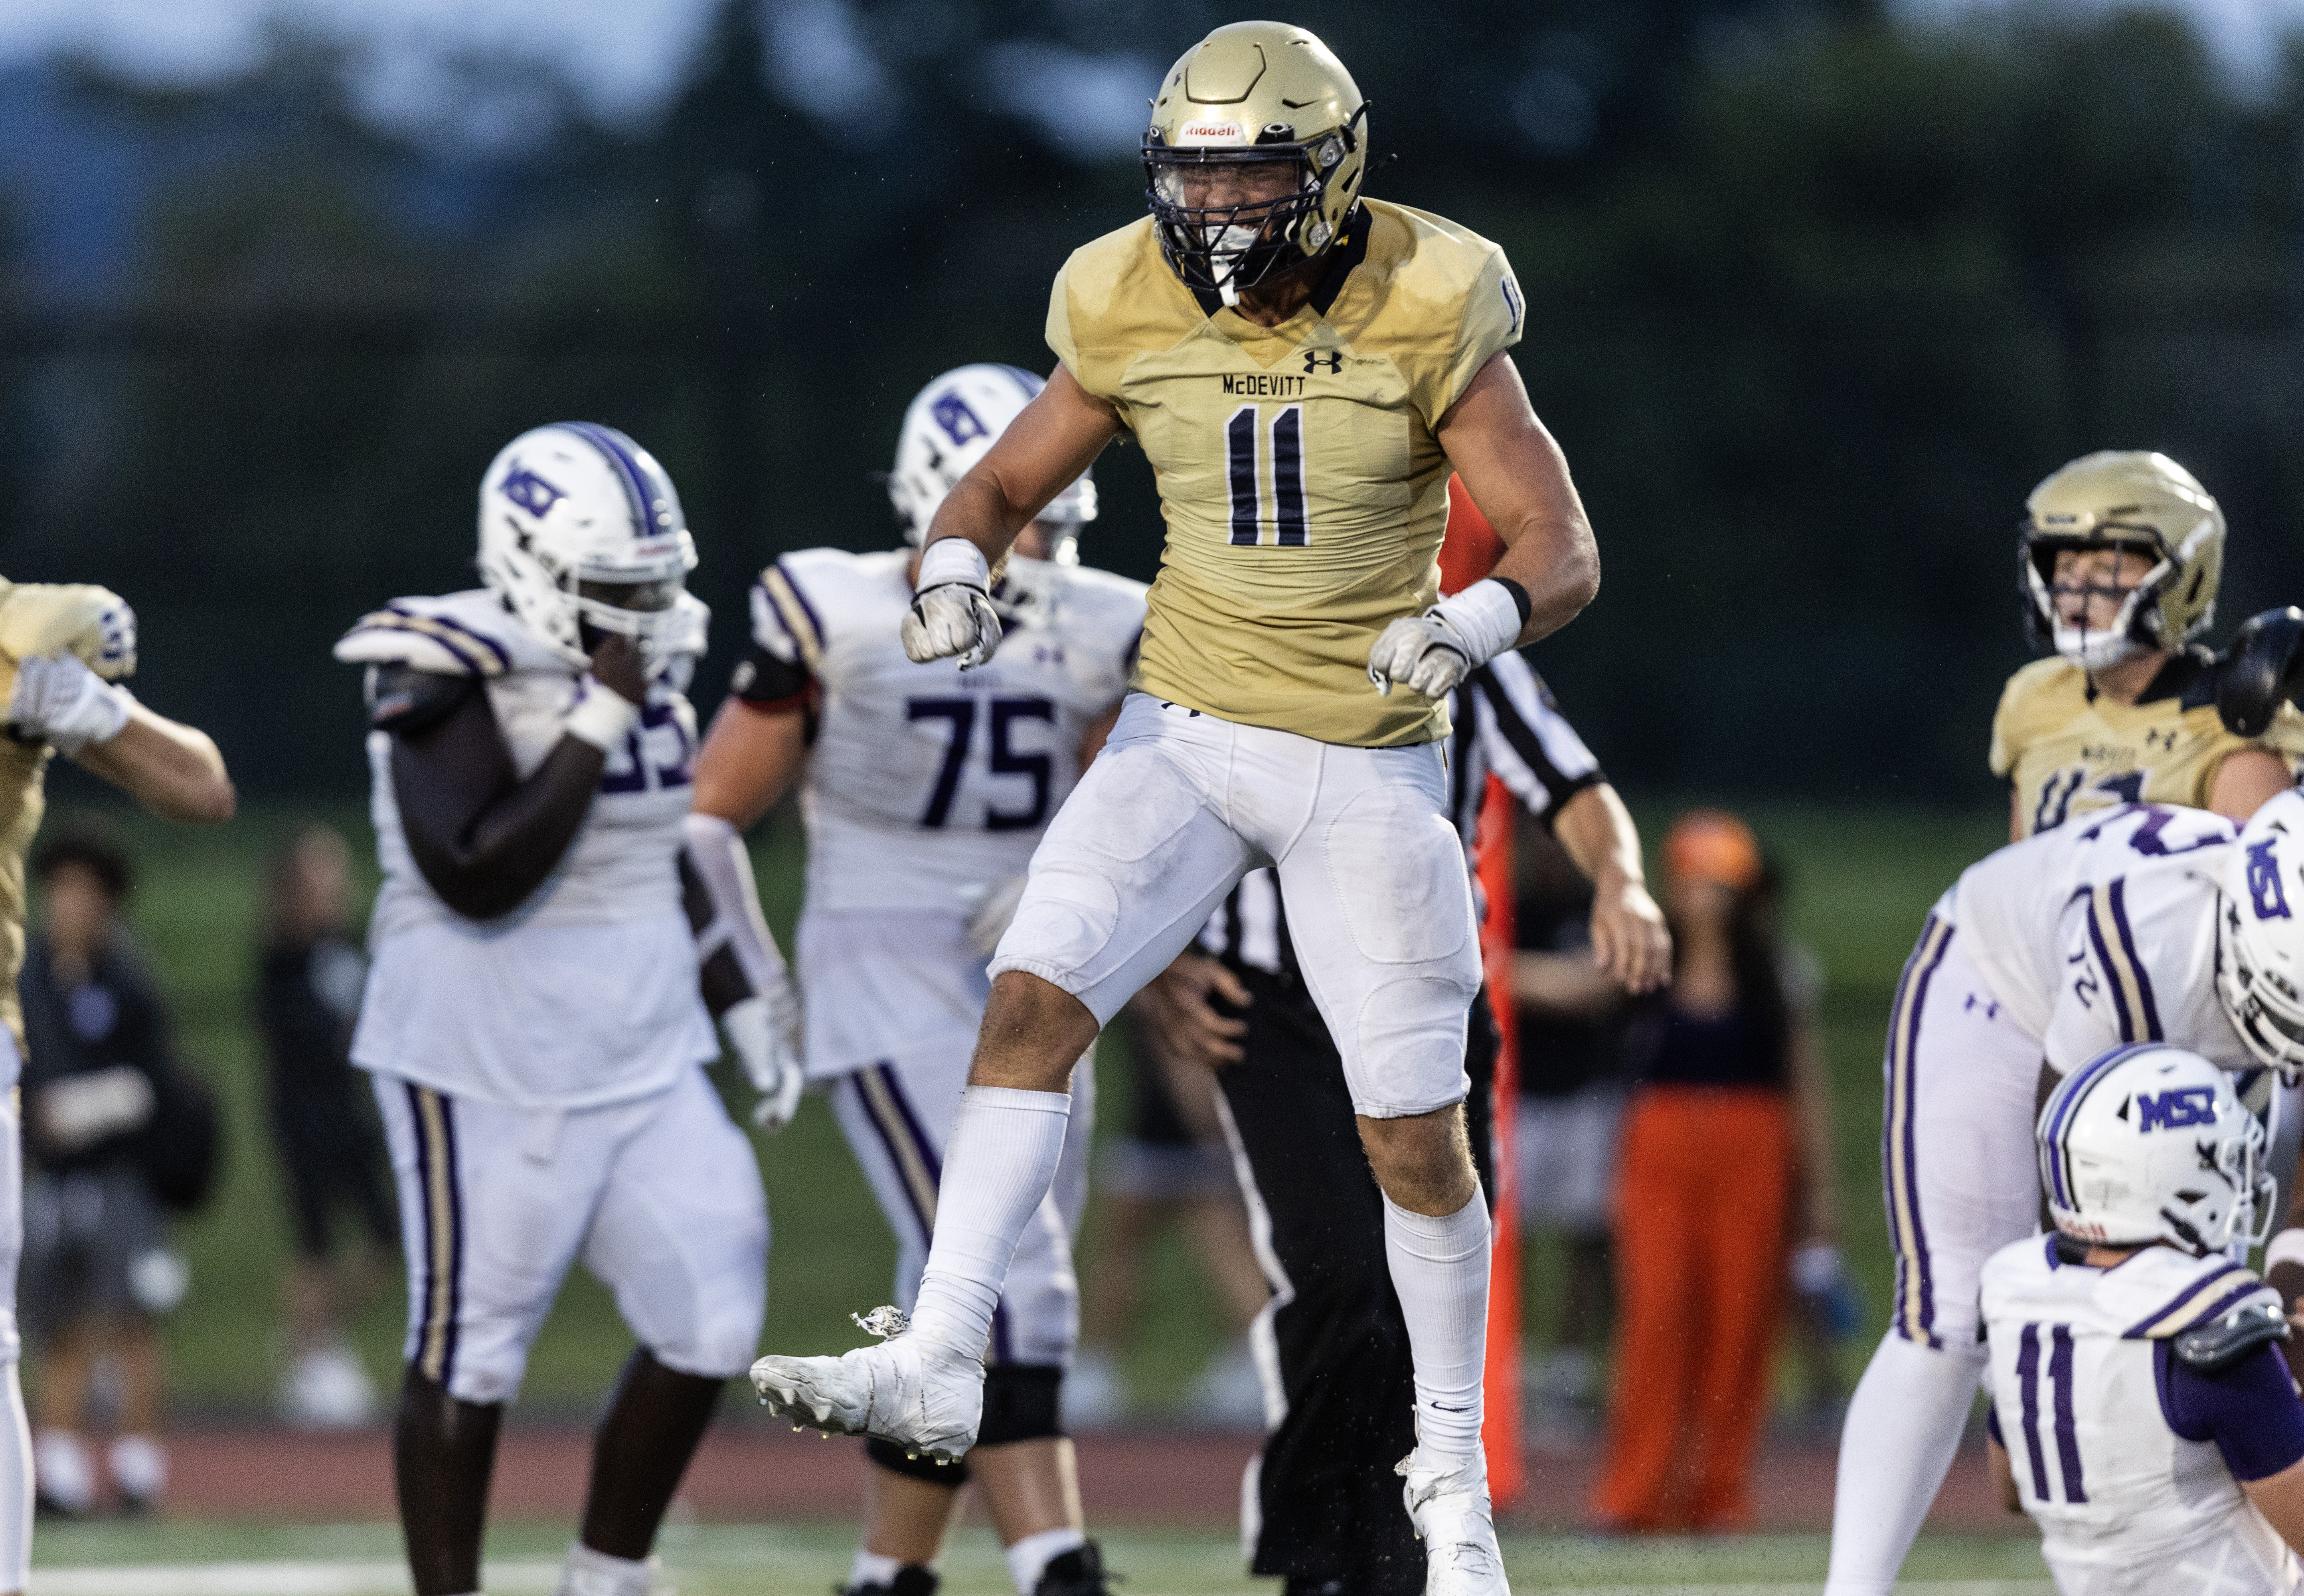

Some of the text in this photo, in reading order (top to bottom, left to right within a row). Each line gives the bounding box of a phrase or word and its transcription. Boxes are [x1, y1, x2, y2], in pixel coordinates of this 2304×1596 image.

[1223, 374, 1305, 395] McDEVITT
[1223, 403, 1310, 546] 11
[906, 698, 1053, 828] 75
[2016, 1322, 2089, 1504] 11
